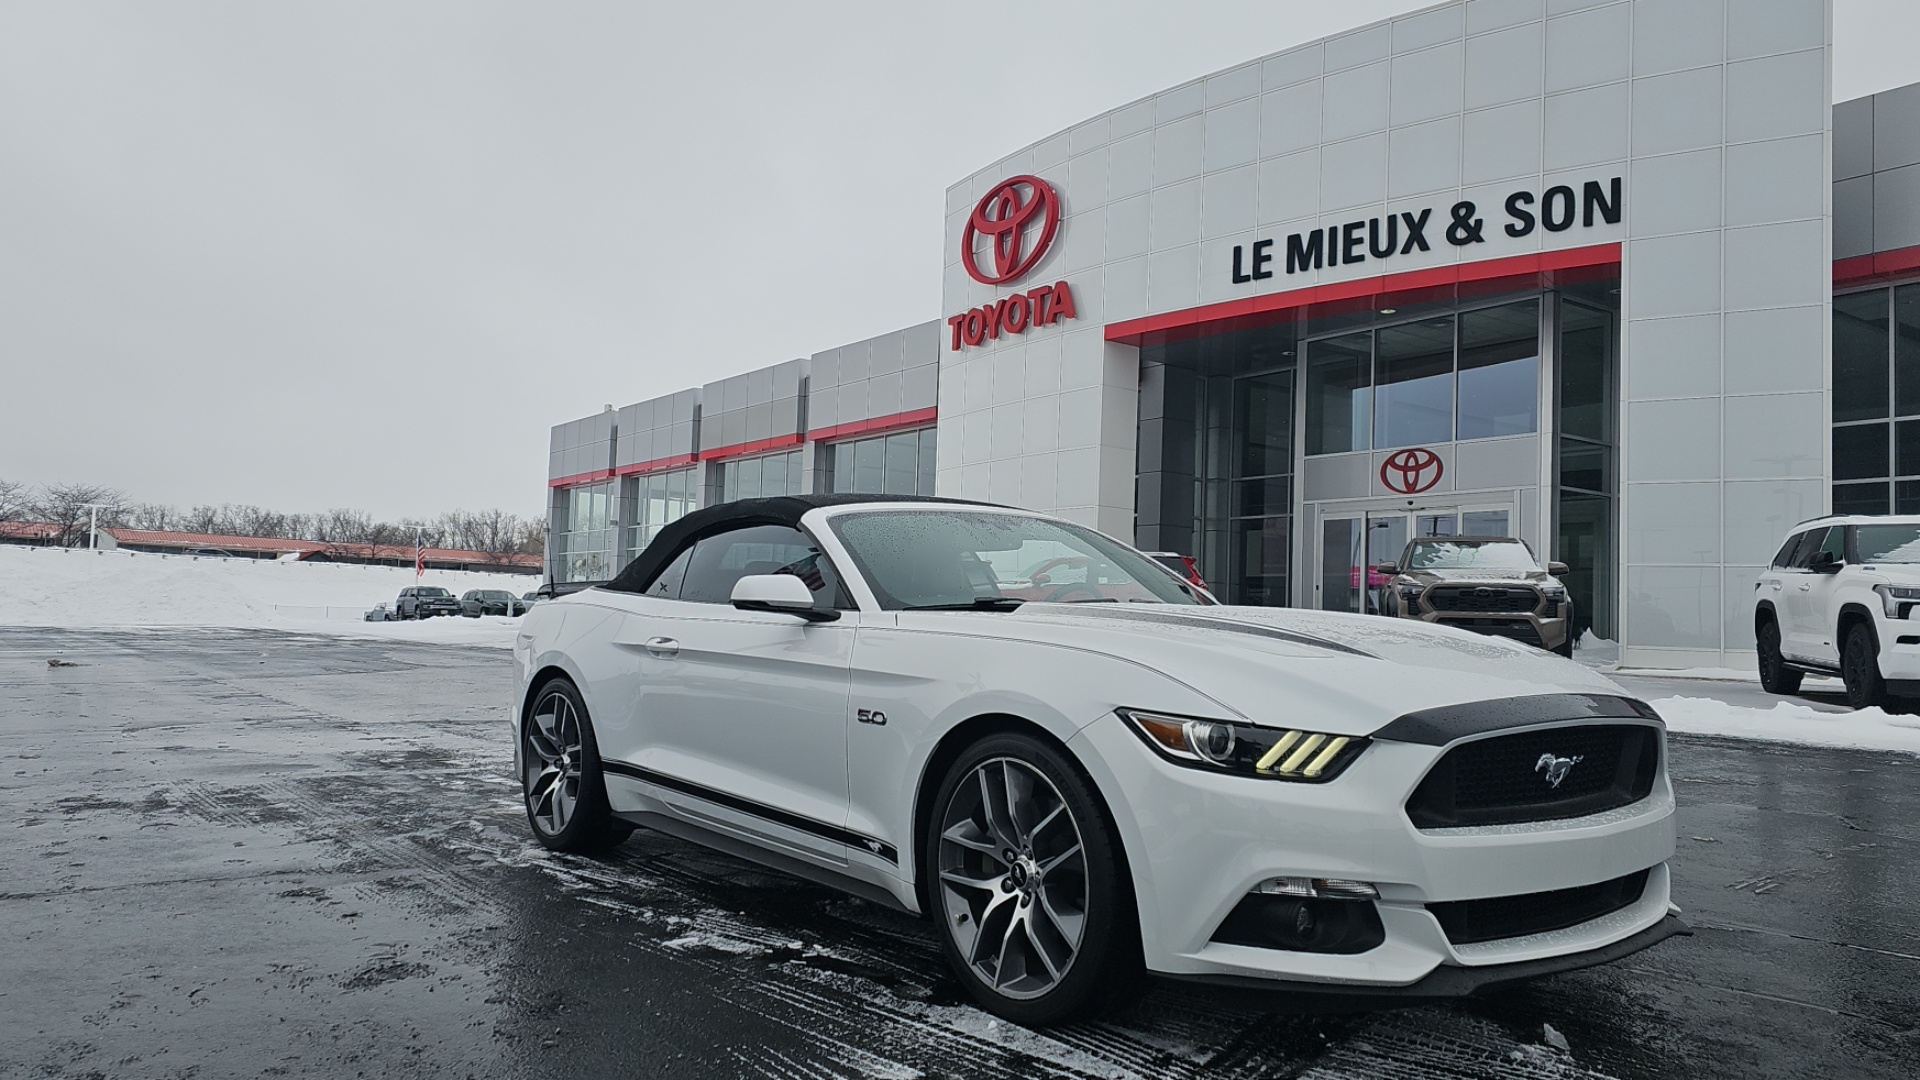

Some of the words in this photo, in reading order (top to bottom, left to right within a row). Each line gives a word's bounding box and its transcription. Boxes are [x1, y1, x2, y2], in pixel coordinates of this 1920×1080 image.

[1232, 239, 1273, 284] LE
[1286, 208, 1432, 274] MIEUX
[1445, 201, 1485, 246] &
[1504, 176, 1622, 238] SON
[948, 280, 1077, 351] TOYOTA
